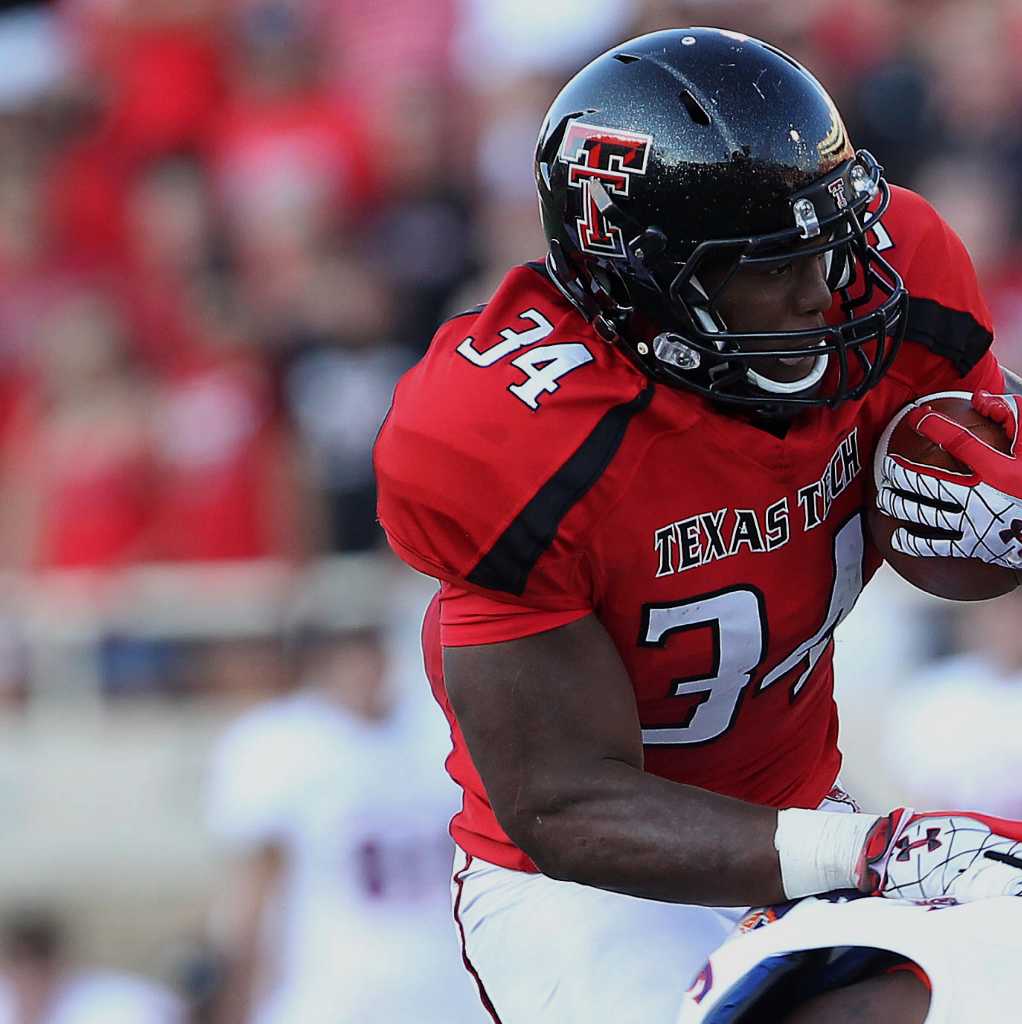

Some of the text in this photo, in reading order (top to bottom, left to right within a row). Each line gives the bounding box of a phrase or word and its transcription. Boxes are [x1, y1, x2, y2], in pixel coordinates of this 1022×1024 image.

[455, 307, 595, 412] 34
[654, 496, 790, 578] TEXAS
[638, 512, 868, 745] 34
